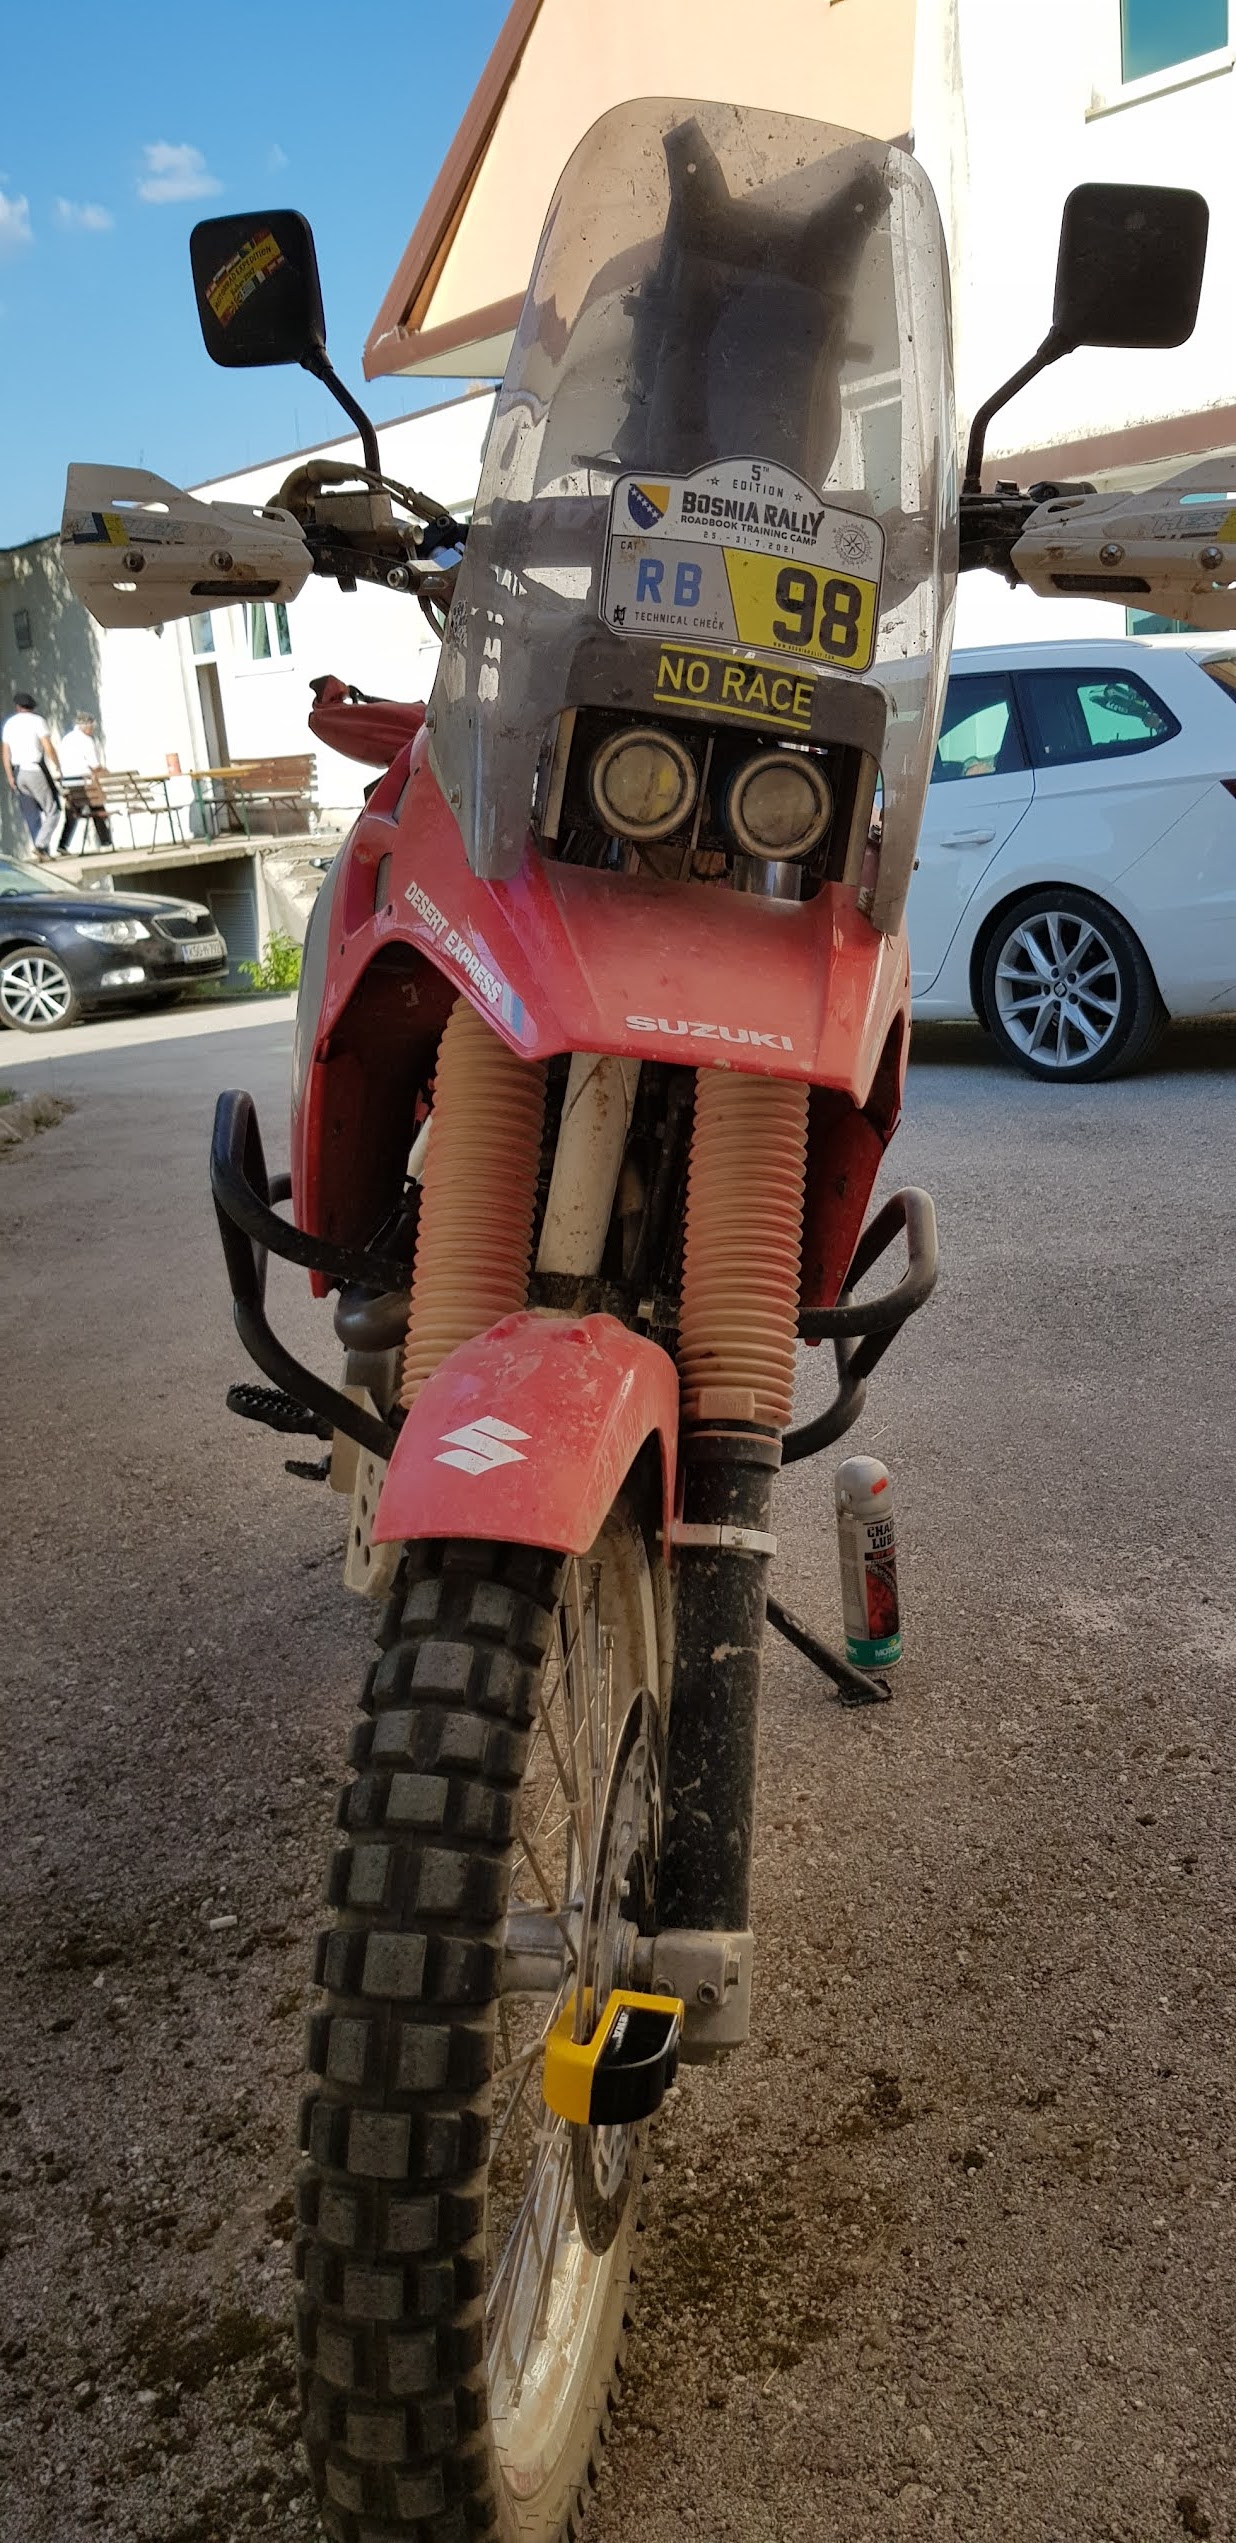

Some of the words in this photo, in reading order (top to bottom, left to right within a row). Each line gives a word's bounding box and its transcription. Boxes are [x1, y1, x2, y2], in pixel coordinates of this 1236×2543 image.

[235, 245, 272, 276] EXPEDITION
[732, 479, 784, 498] EDITION
[680, 515, 738, 530] ROADBOOK
[741, 523, 788, 540] TRAINING
[789, 534, 817, 547] CAMP
[681, 491, 760, 524] BOSNIA
[764, 503, 825, 538] RALLY
[635, 611, 688, 626] TECHNICAL
[693, 617, 725, 631] CHECK
[772, 566, 863, 659] 98
[656, 655, 710, 693] NO
[721, 667, 815, 718] RACE
[404, 880, 449, 936] DESERT
[444, 929, 503, 1004] EXPRESS
[625, 1015, 794, 1051] SUZUKI
